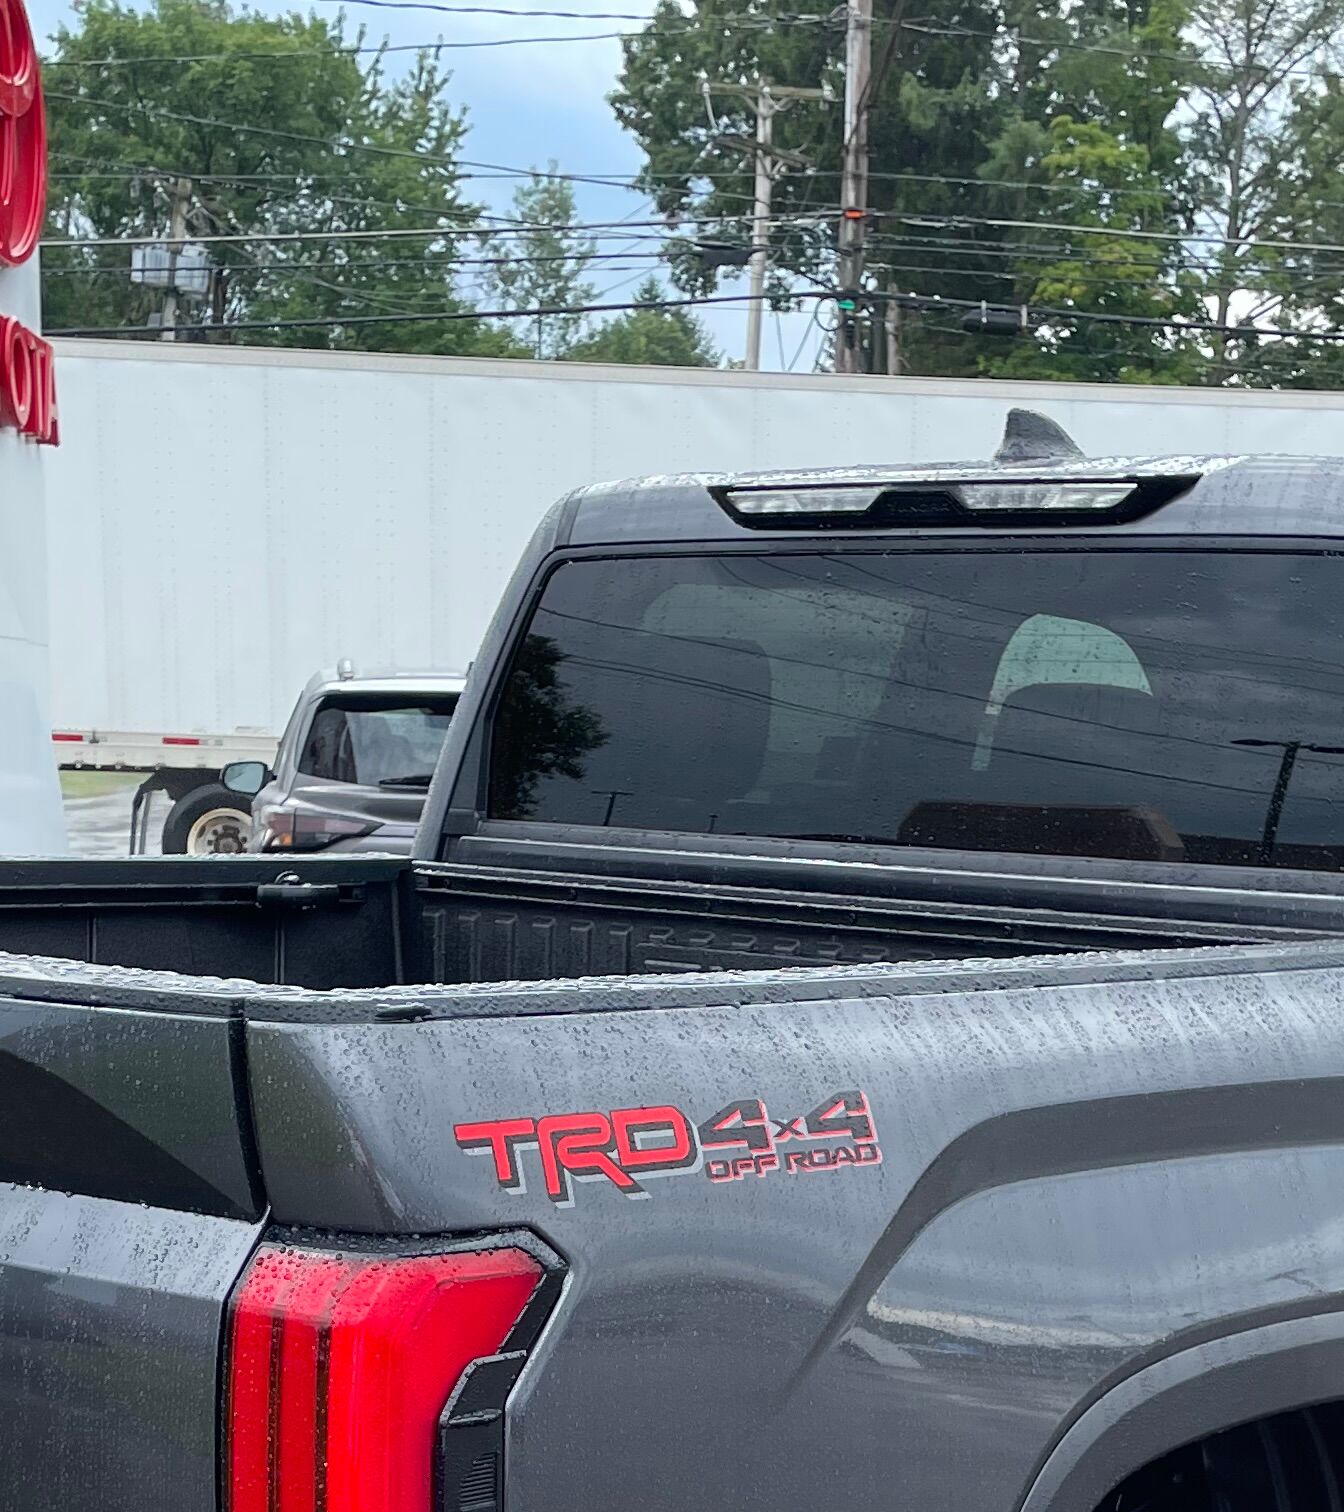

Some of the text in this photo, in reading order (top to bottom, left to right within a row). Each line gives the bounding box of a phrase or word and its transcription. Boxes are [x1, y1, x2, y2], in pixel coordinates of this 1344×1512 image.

[453, 1089, 881, 1209] TRD 4x4
[705, 1143, 883, 1184] OFF ROAD
